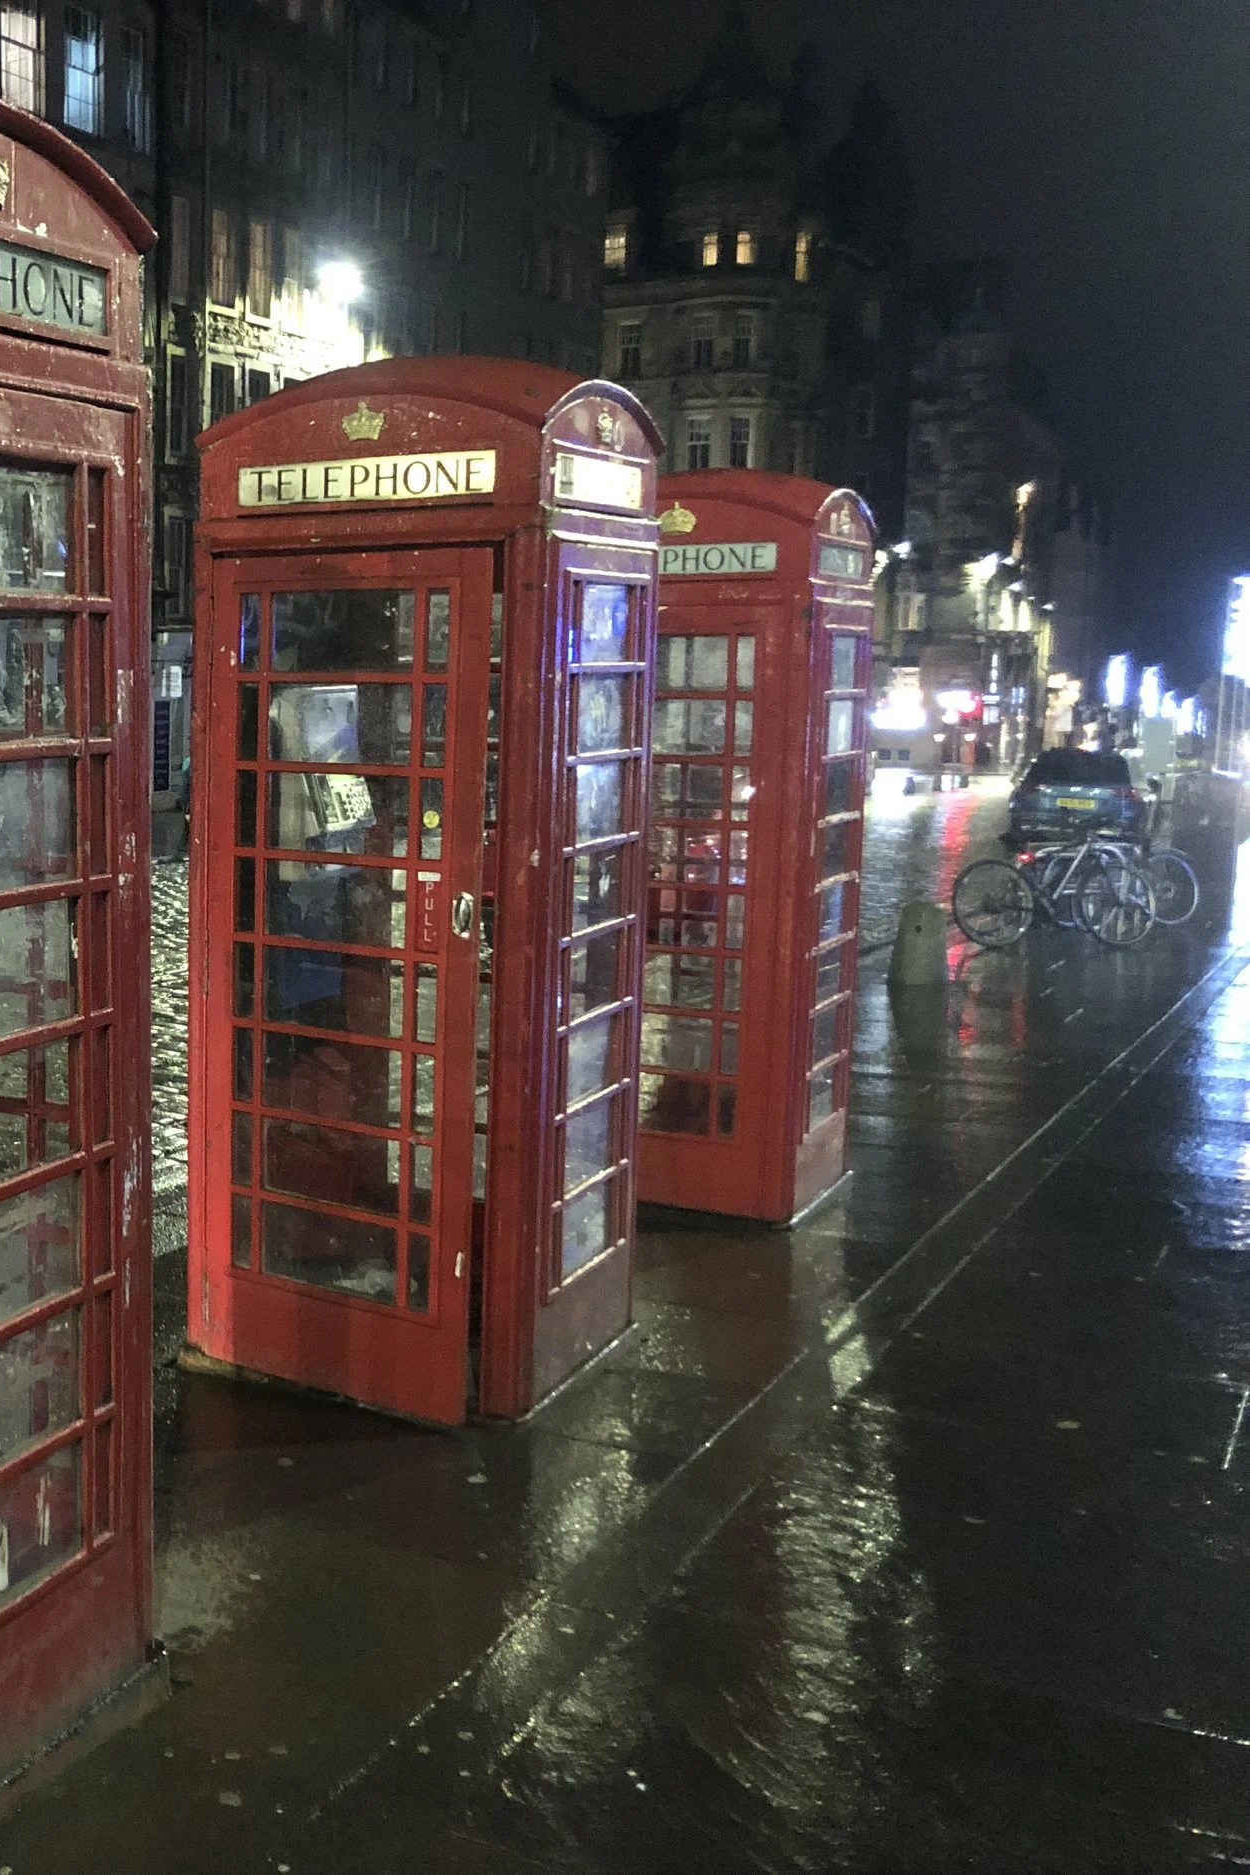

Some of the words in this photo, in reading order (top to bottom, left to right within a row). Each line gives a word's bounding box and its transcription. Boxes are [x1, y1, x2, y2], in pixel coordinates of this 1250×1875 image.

[250, 457, 485, 502] TELEPHONE
[662, 545, 768, 572] PHONE
[424, 882, 434, 942] PULL
